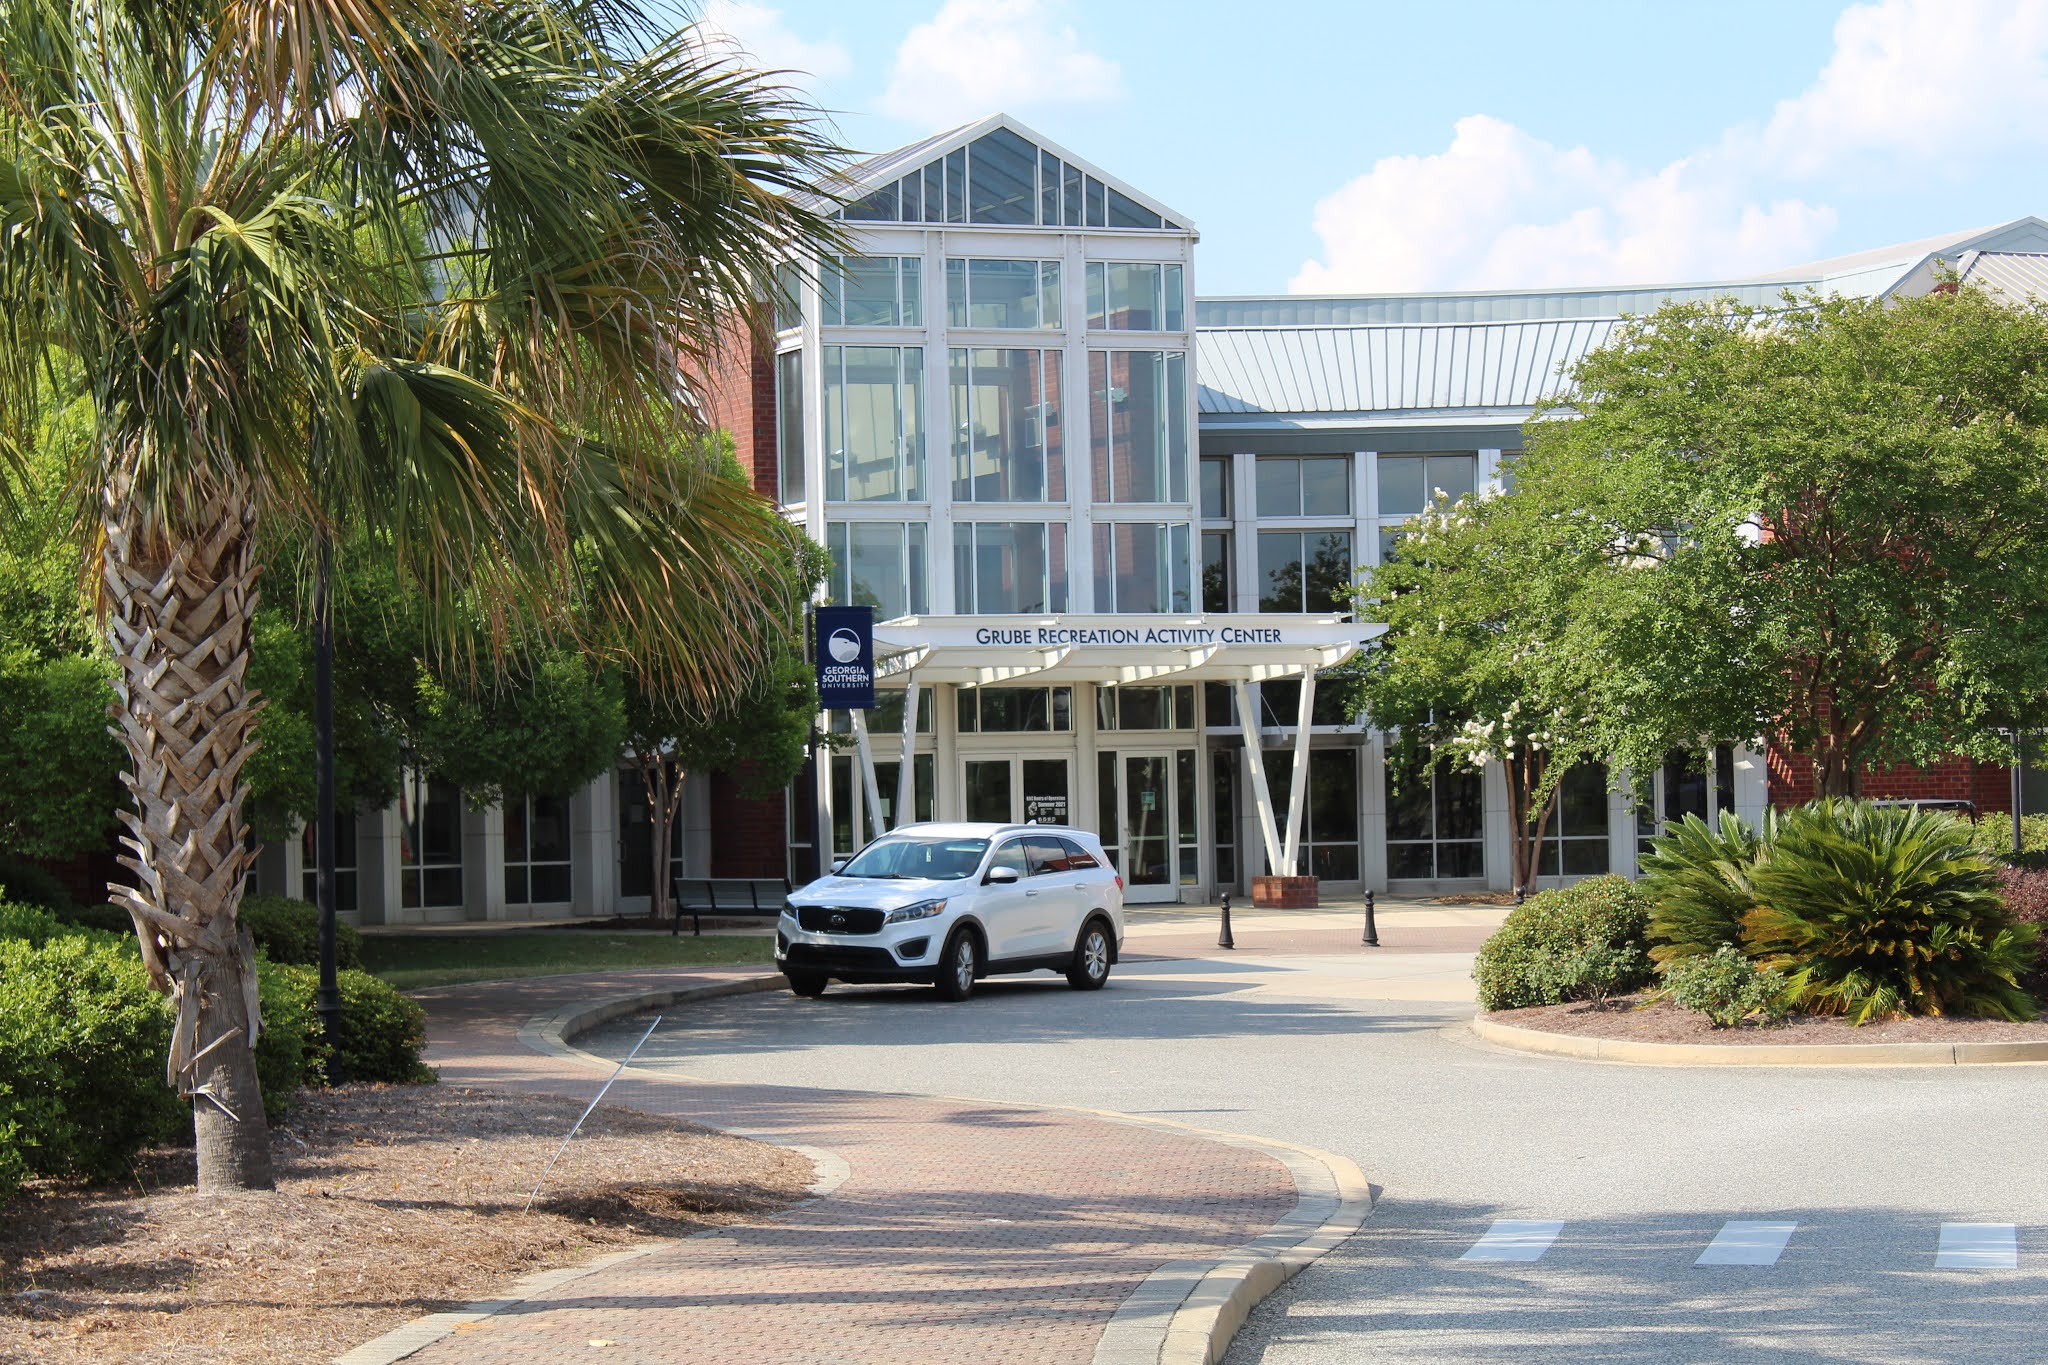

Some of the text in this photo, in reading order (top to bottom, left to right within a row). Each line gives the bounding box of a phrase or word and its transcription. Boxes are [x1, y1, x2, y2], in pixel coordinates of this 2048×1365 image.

[976, 627, 1282, 644] GRUBE RECREATION ACTIVITY CENTER
[825, 666, 866, 675] GEORGIA
[822, 674, 870, 683] SOUTHERN
